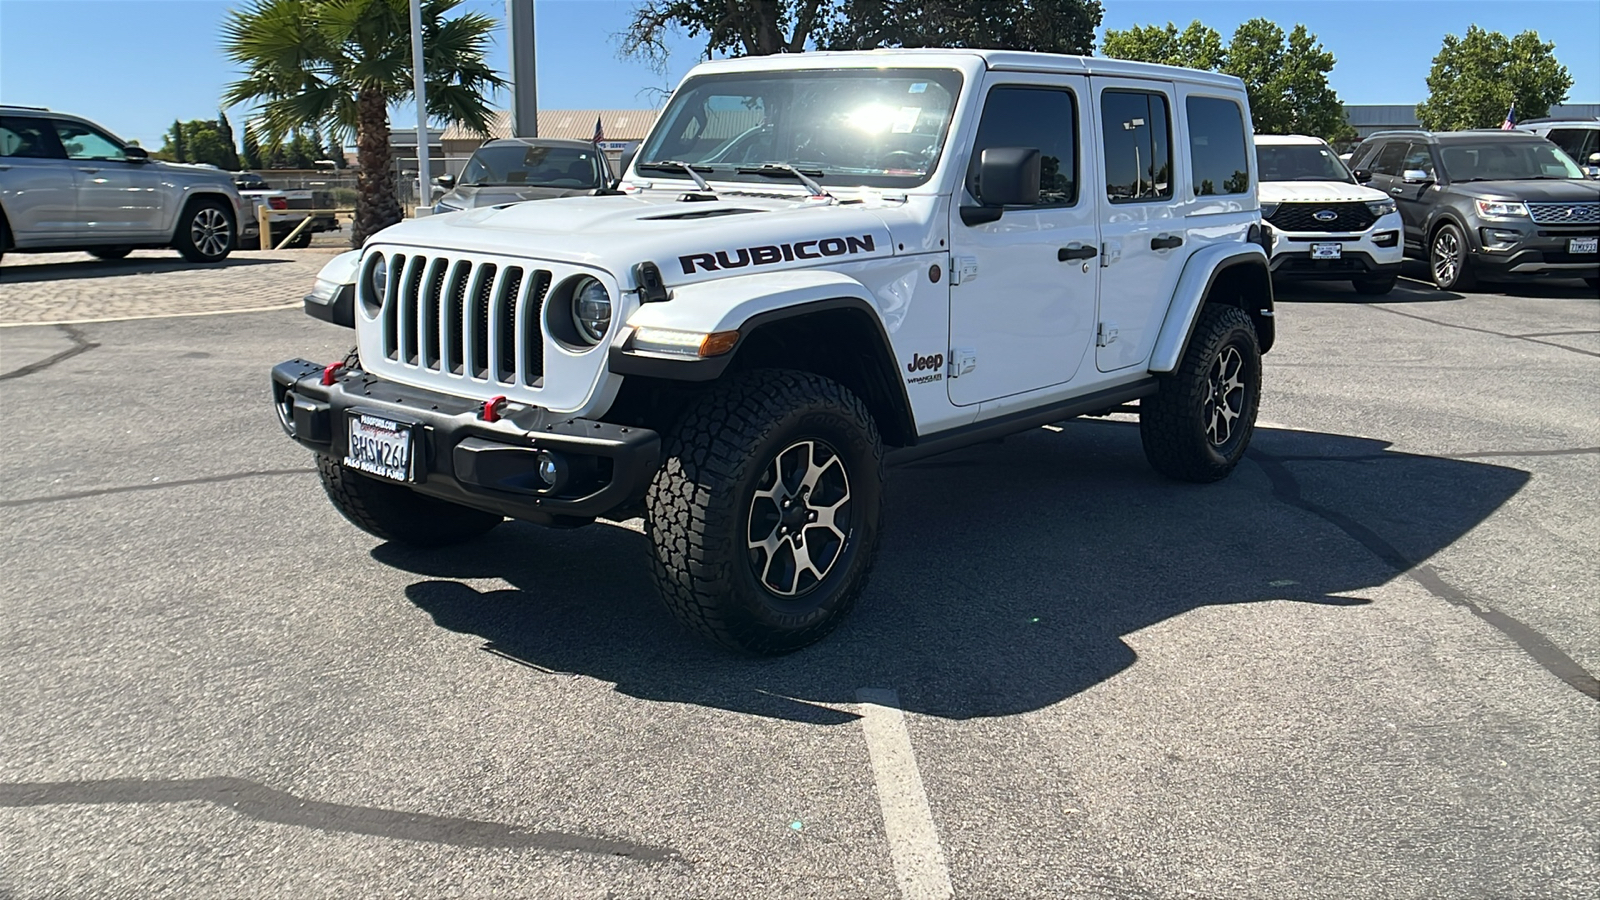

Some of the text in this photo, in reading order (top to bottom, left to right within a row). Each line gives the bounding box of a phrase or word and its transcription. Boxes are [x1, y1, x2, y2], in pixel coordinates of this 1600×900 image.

[678, 234, 875, 275] RUBICON
[907, 352, 944, 373] Jeep
[907, 373, 943, 384] WRANGLER
[343, 456, 361, 470] PASO
[360, 462, 387, 477] ROBLES
